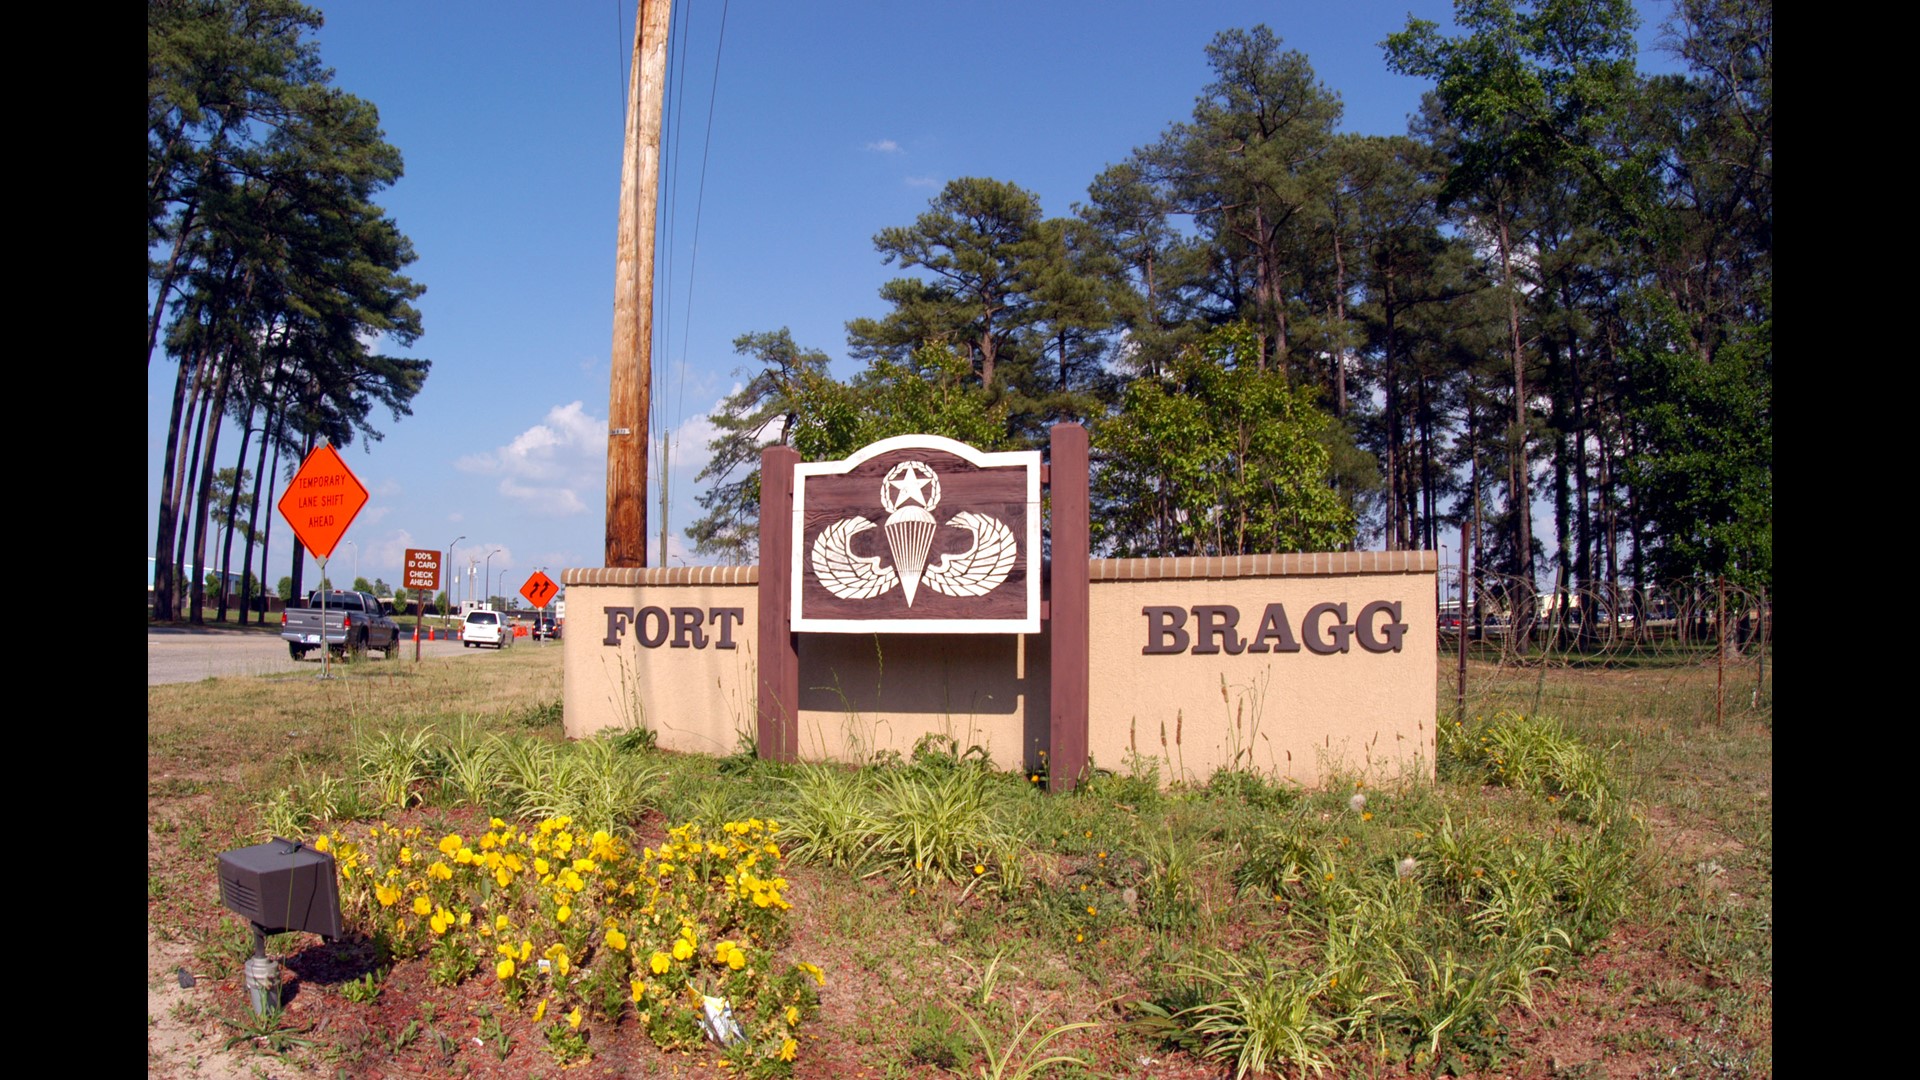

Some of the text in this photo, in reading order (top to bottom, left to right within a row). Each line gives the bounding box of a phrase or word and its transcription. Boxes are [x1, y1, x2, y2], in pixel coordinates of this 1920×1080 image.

[299, 474, 346, 489] TEMPORARY
[298, 494, 344, 508] LANE SHIFT
[308, 515, 334, 528] AHEAD
[414, 552, 432, 560] 100%
[408, 560, 437, 569] ID CARD
[409, 570, 433, 579] CHECK
[409, 578, 433, 587] AHEAD
[602, 600, 1409, 656] FORT BRAGG
